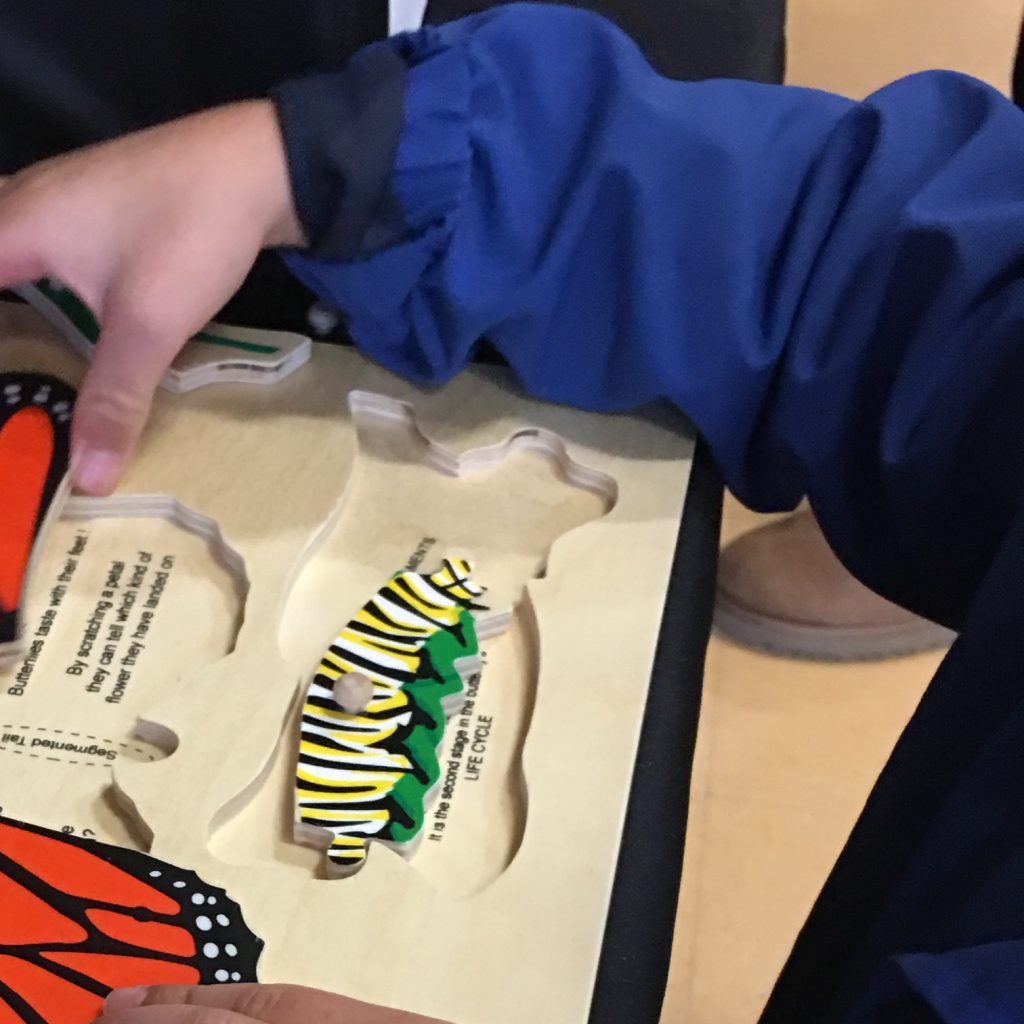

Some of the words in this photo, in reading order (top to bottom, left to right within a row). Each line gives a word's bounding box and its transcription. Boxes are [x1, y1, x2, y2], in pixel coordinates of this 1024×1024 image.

[137, 551, 153, 563] of
[160, 554, 175, 570] on
[105, 560, 126, 589] petal
[126, 563, 148, 592] kind
[102, 589, 114, 599] a
[142, 570, 170, 611] landed
[34, 608, 58, 638] taste
[49, 583, 68, 607] with
[116, 591, 136, 624] which
[77, 599, 114, 658] scratching
[106, 624, 125, 642] tell
[131, 609, 154, 640] have
[99, 642, 118, 667] can
[121, 634, 146, 667] they
[66, 659, 89, 677] By
[86, 664, 111, 693] they
[105, 665, 131, 705] flower
[457, 717, 470, 729] in
[472, 715, 493, 753] CYCLE
[2, 733, 26, 746] Tail
[31, 738, 118, 760] Segmented
[451, 730, 470, 760] stage
[441, 760, 460, 800] second
[464, 756, 484, 781] LIFE
[434, 801, 450, 821] the
[428, 832, 443, 842] It
[433, 822, 445, 833] is
